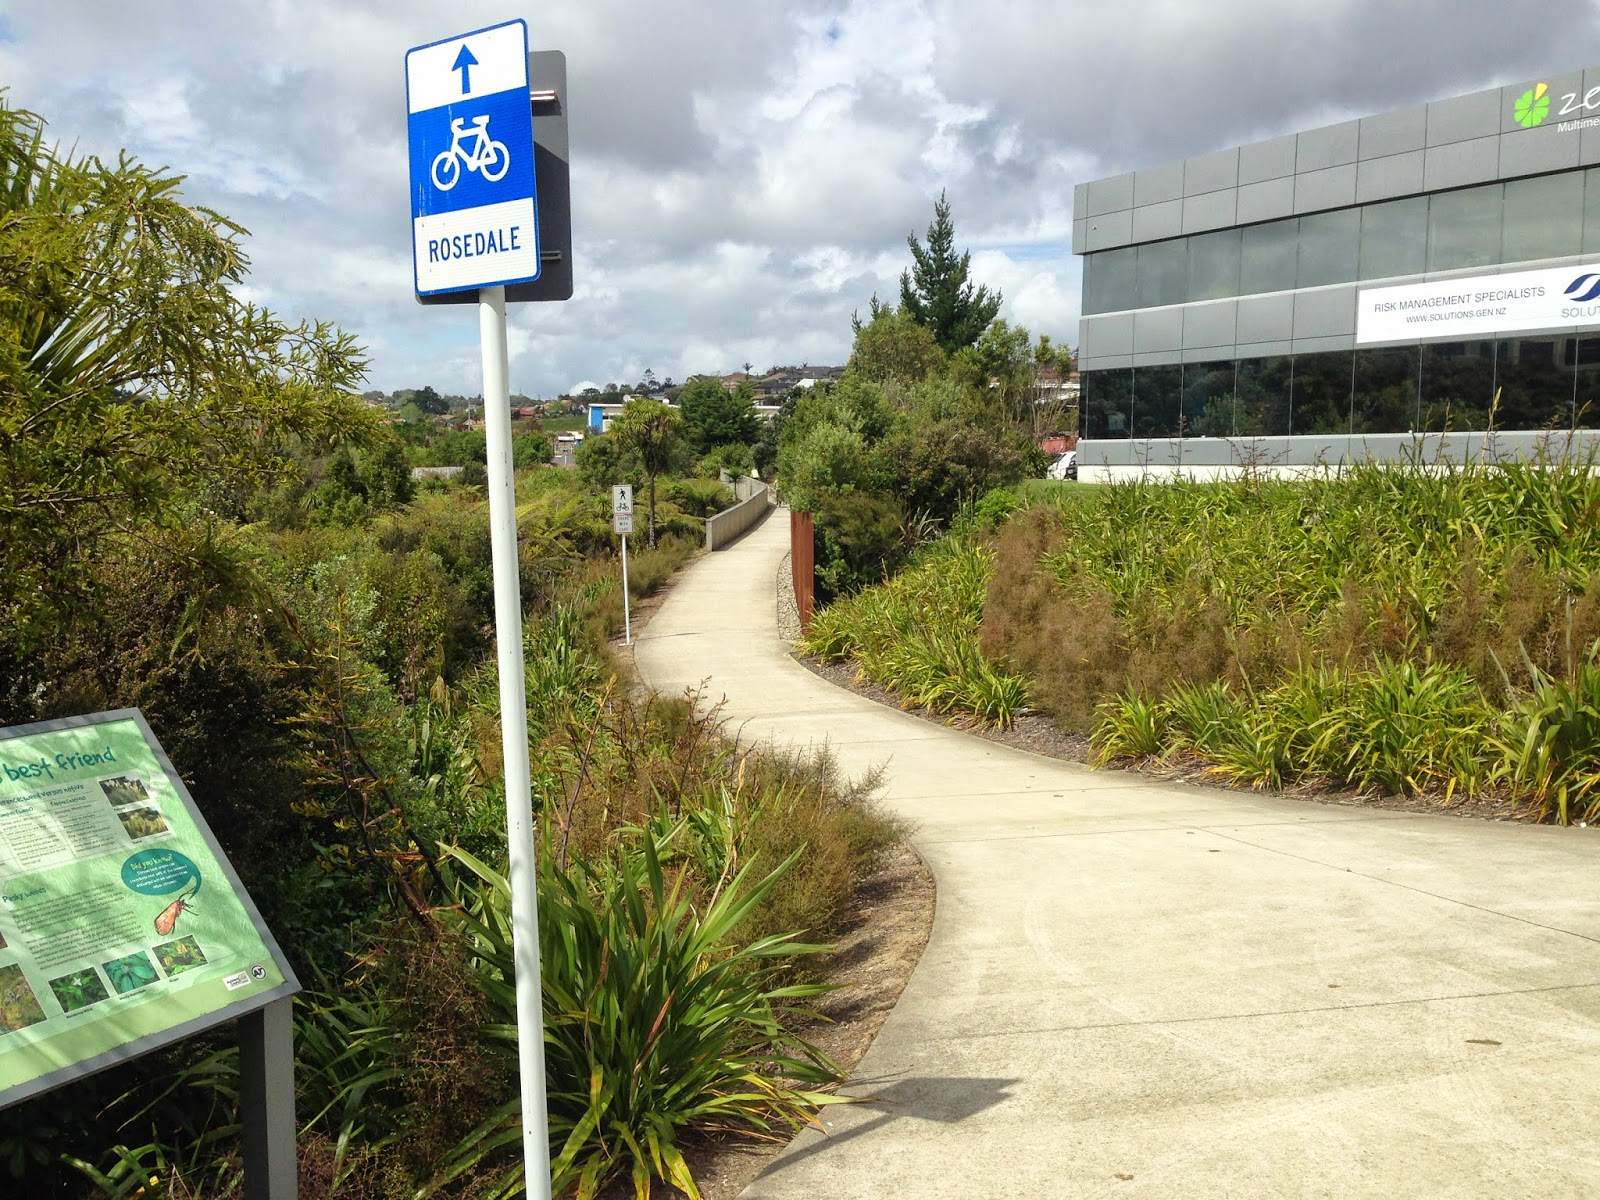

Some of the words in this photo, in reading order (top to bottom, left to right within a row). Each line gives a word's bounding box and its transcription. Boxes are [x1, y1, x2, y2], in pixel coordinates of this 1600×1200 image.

[1557, 118, 1600, 133] Multime
[428, 226, 521, 263] ROSEDALE
[1374, 302, 1397, 313] RISK
[1399, 294, 1472, 310] MANAGEMENT
[1474, 286, 1546, 303] SPECIALISTS
[1406, 307, 1507, 323] WWW.SOLUTIONS.GEN.NZ
[2, 757, 54, 781] best
[55, 746, 116, 771] friend
[40, 788, 64, 797] versus
[63, 783, 85, 793] native
